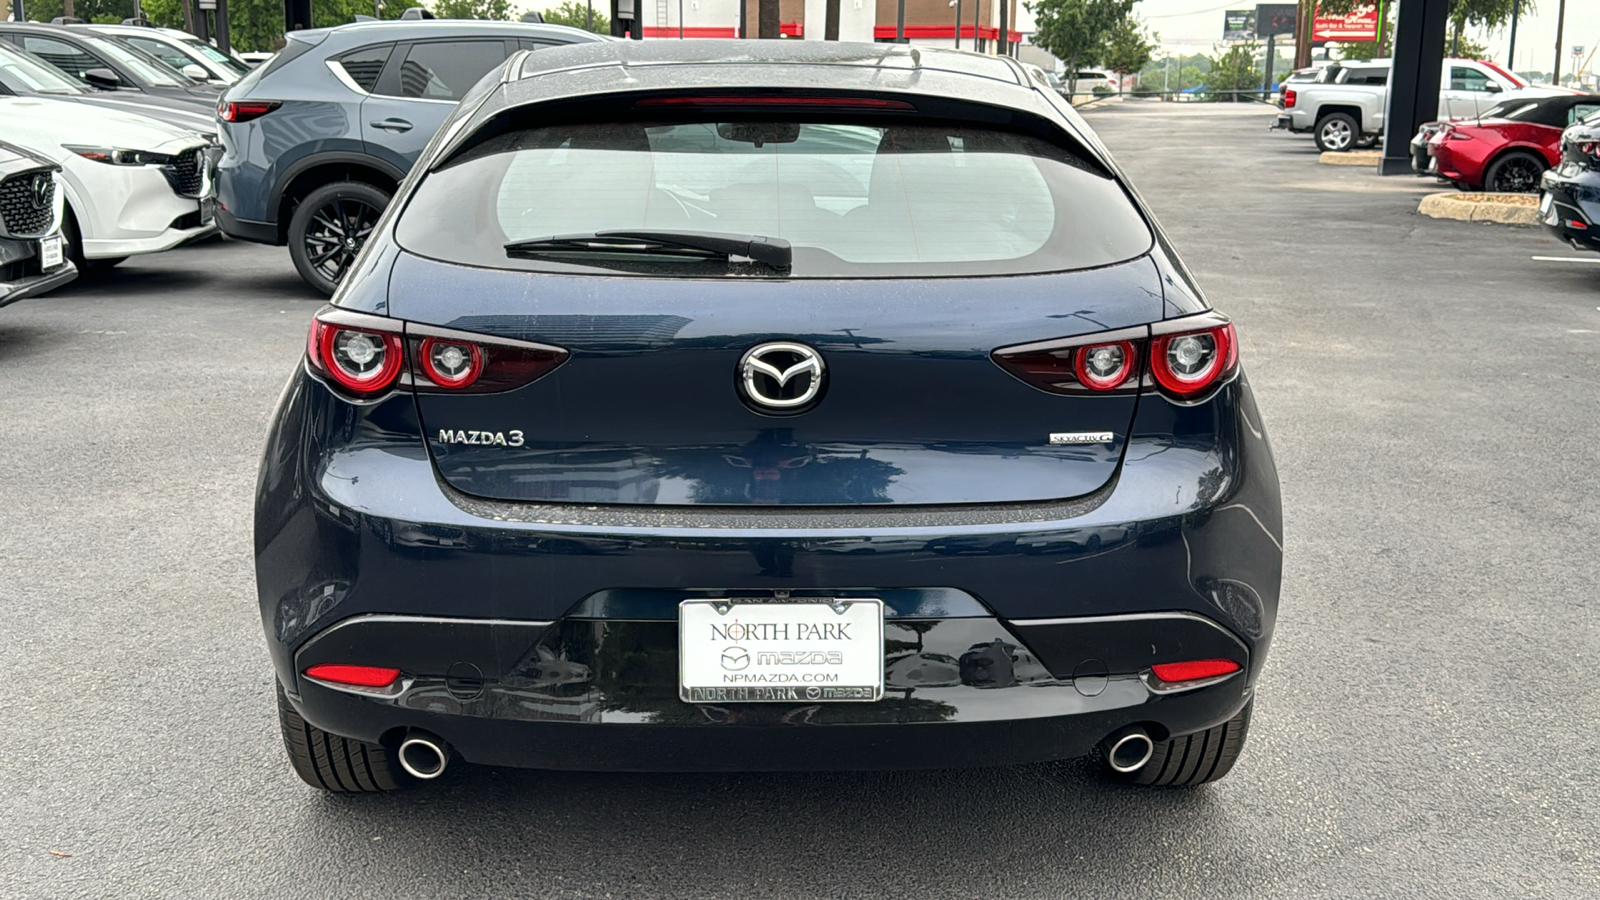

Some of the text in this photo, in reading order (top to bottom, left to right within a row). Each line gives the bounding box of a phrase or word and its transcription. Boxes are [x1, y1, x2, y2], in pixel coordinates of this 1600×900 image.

[710, 622, 852, 641] NORTH PARK
[723, 673, 838, 683] NPMAZDA.COM
[693, 687, 749, 700] NORTH
[754, 687, 798, 700] PARK
